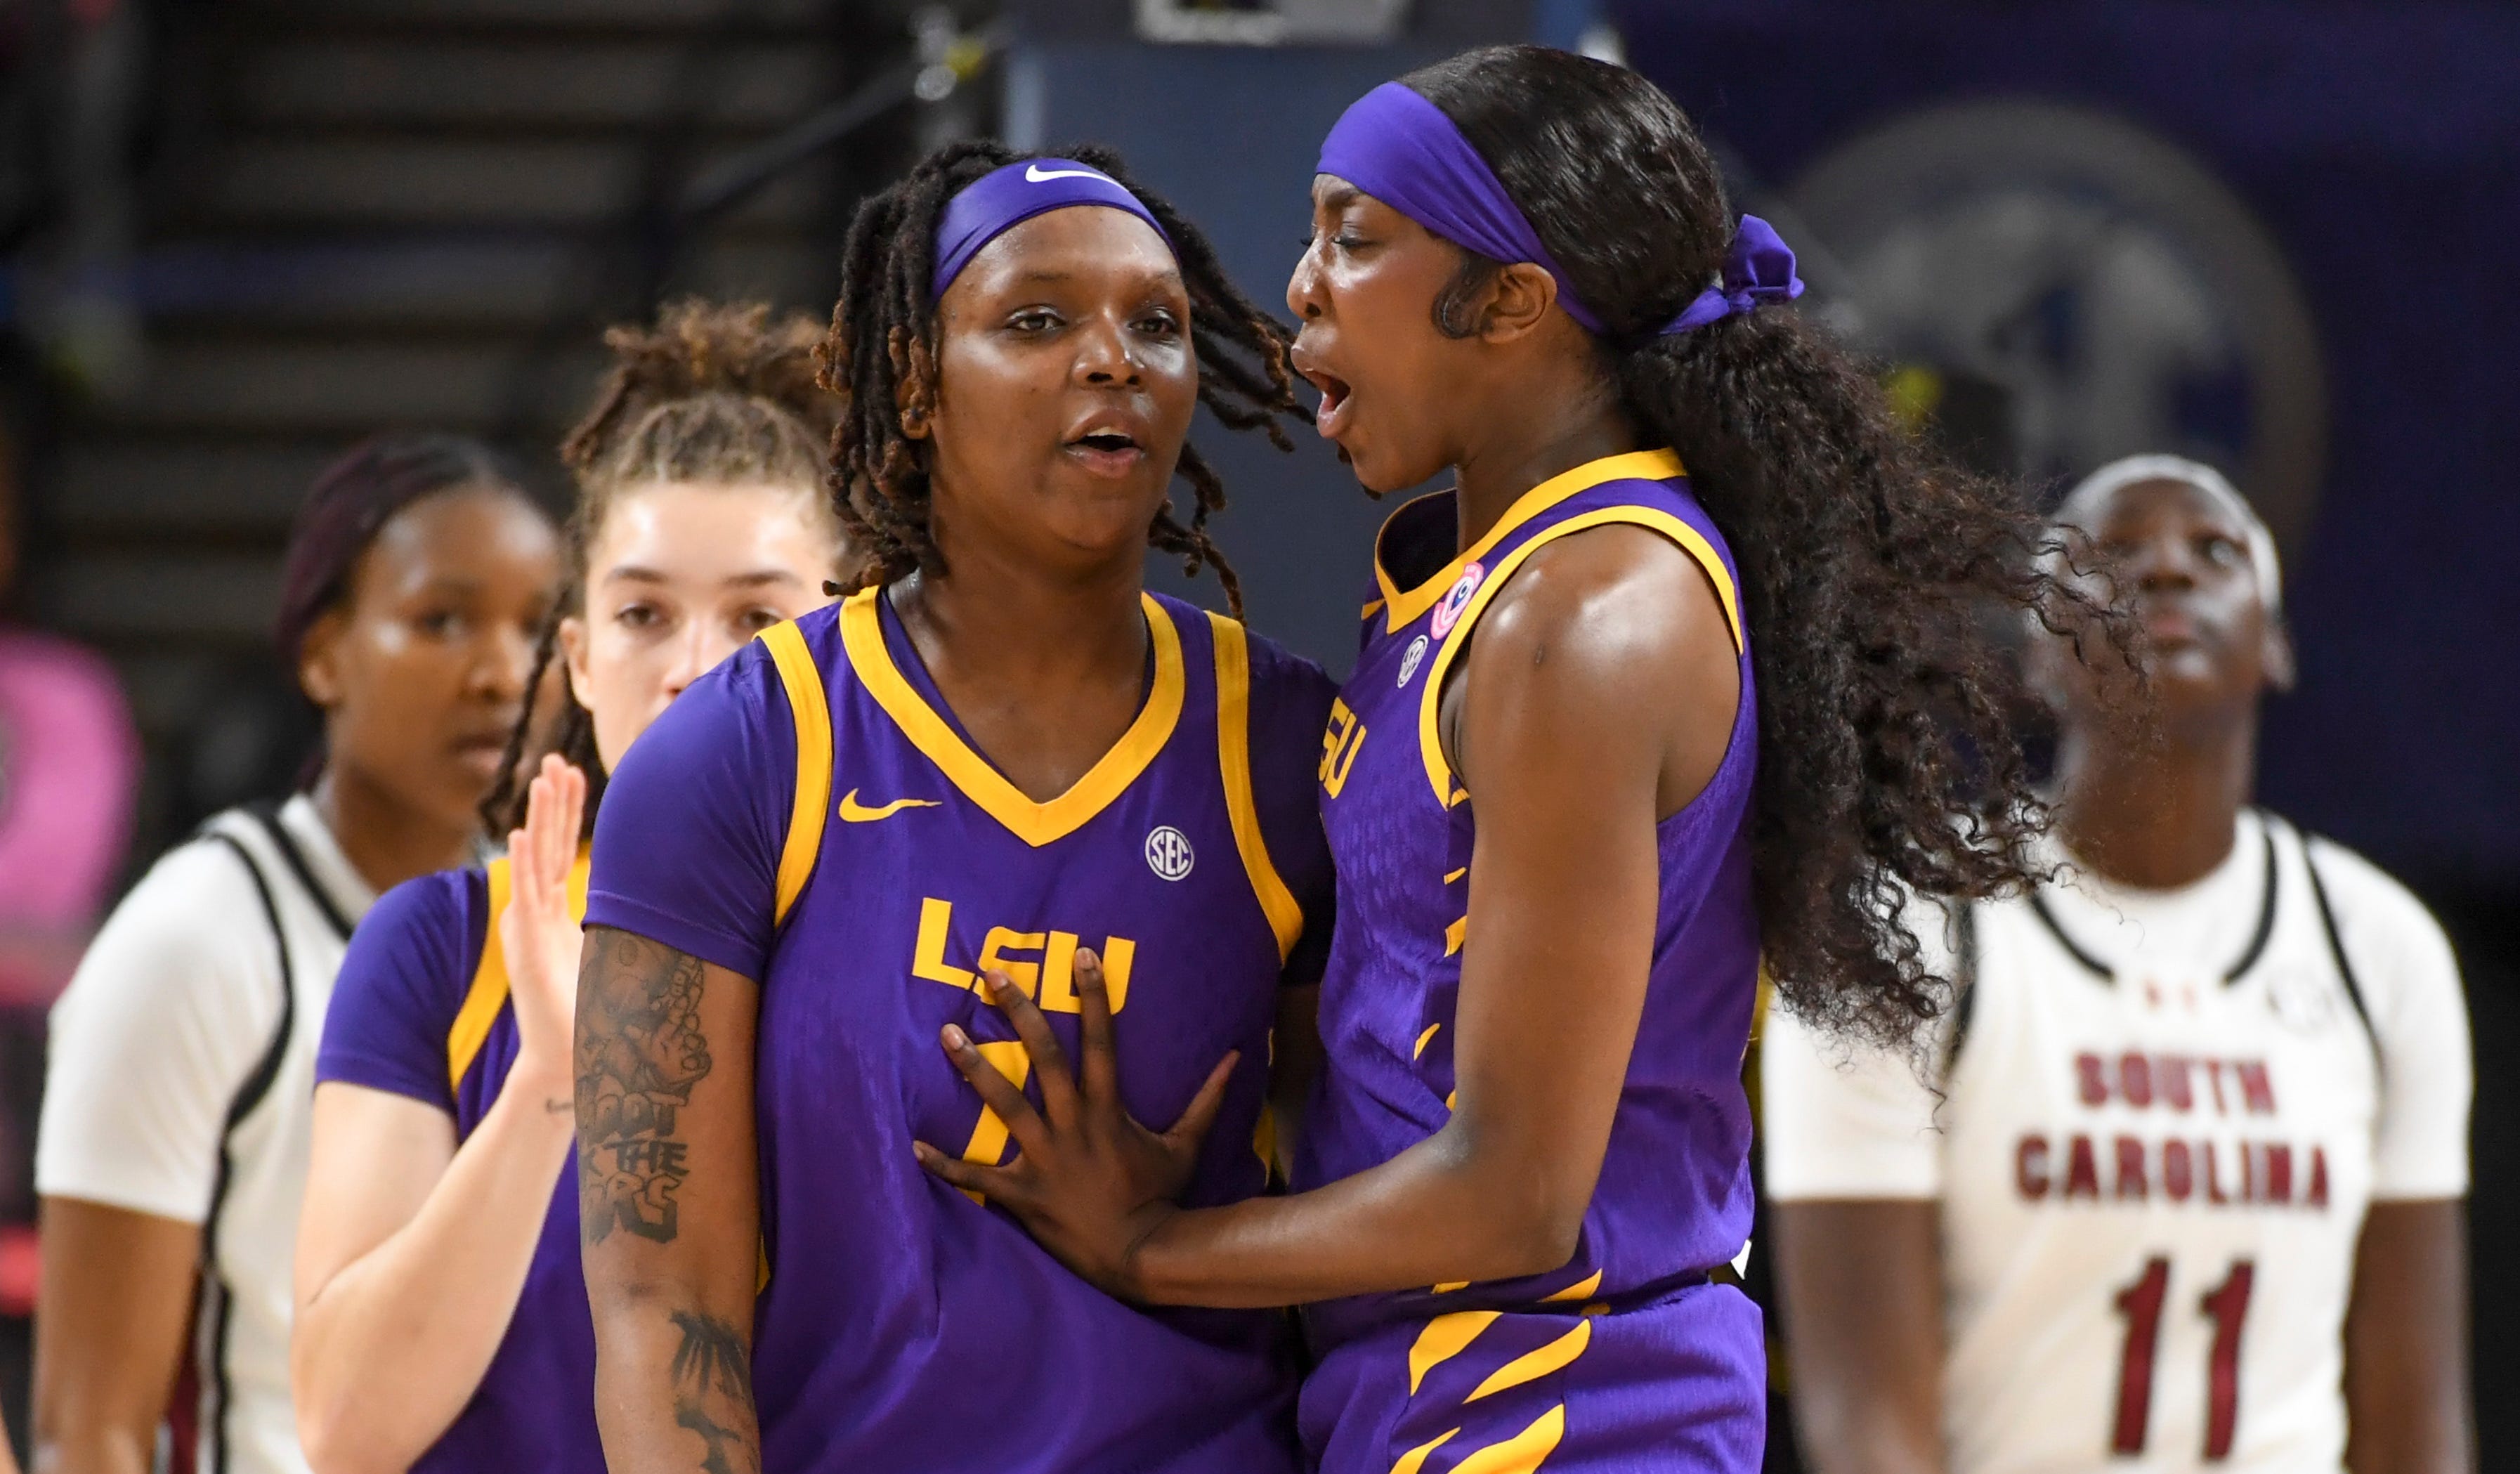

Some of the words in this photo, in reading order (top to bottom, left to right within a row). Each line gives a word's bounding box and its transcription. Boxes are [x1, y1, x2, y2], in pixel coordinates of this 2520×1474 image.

[1319, 697, 1366, 800] SU
[1151, 830, 1189, 875] SEC
[912, 896, 1136, 1016] LSU
[2075, 1051, 2276, 1117] SOUTH
[603, 1140, 690, 1177] THE
[2015, 1133, 2331, 1210] CAROLINA
[2112, 1256, 2255, 1463] 11
